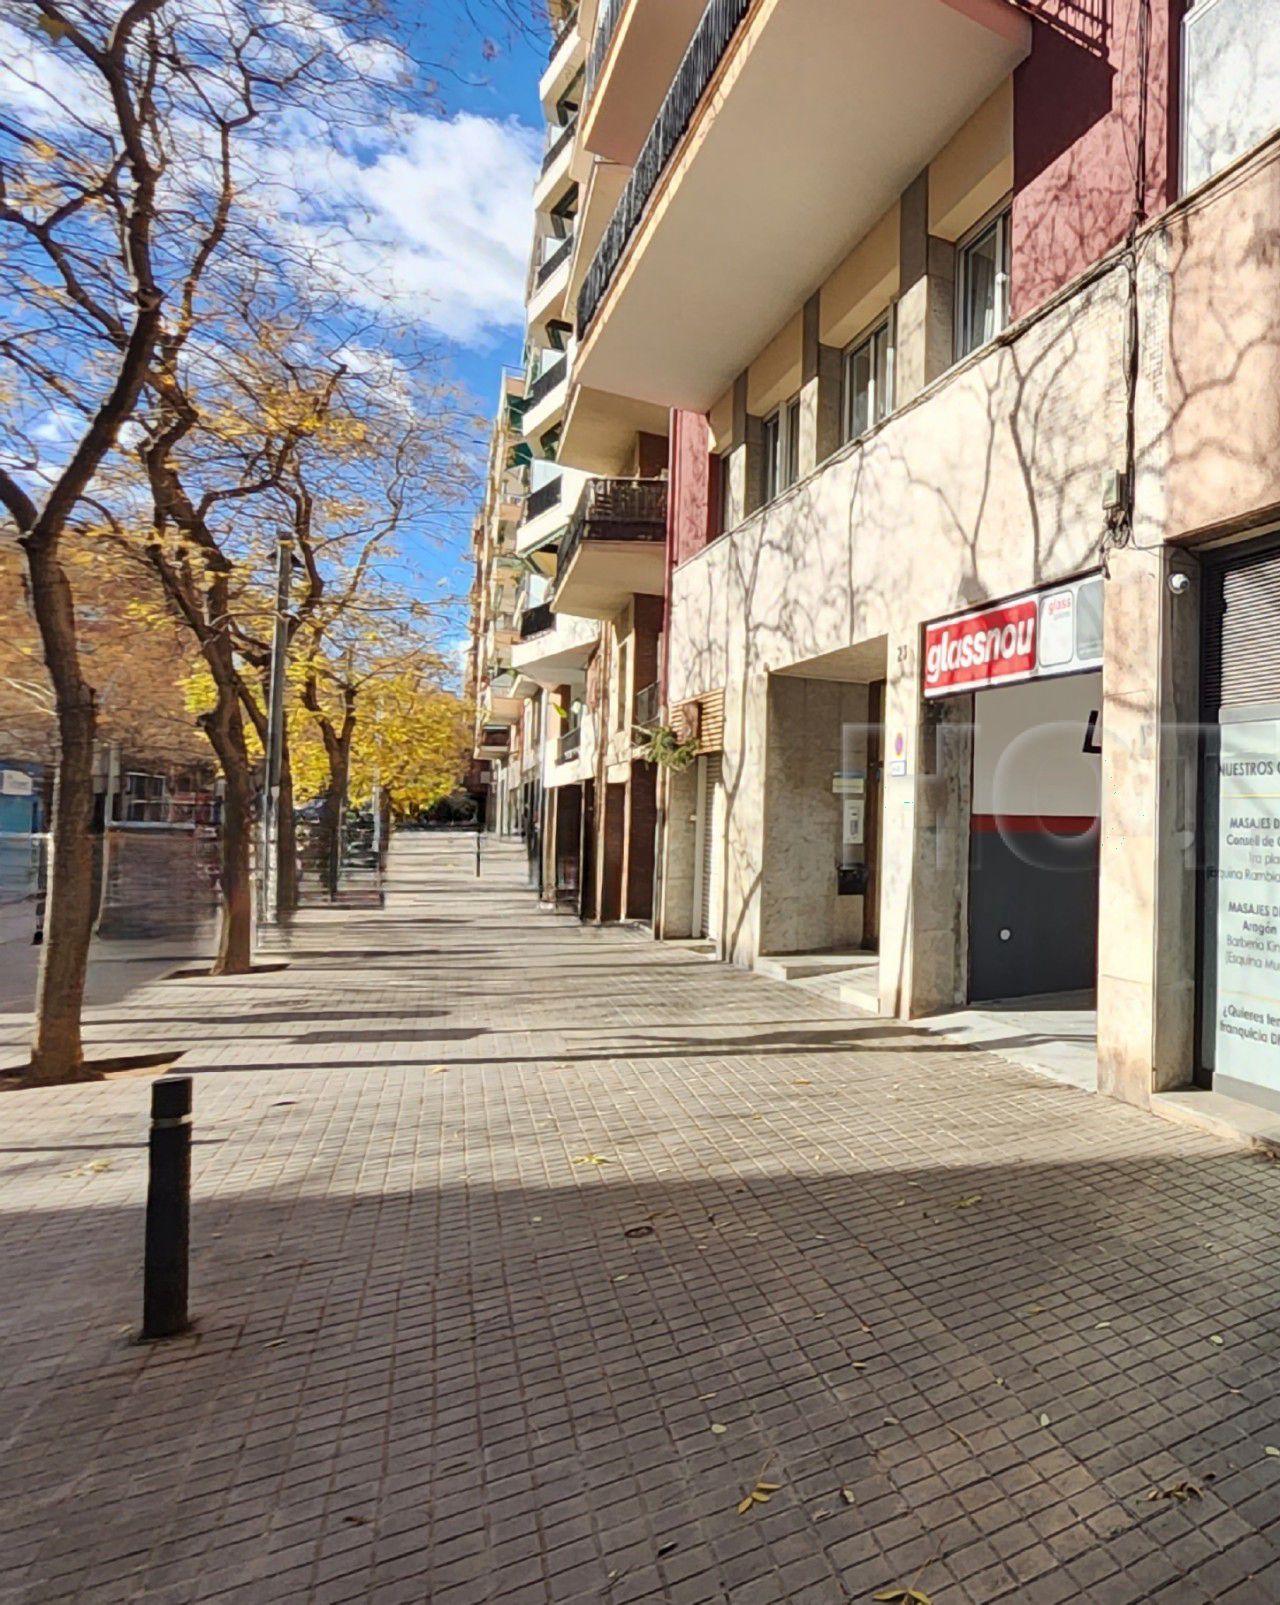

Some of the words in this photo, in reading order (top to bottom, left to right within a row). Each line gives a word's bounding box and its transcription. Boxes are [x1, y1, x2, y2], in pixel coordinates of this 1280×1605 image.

[926, 617, 1035, 684] glassnou
[1217, 761, 1274, 777] NUESTROS
[1230, 817, 1271, 830] MASAJES
[1226, 834, 1260, 847] Consell
[1262, 835, 1274, 848] de
[1228, 901, 1270, 917] MASAJES
[1242, 920, 1278, 936] Aragón
[1219, 1020, 1268, 1043] franquicia
